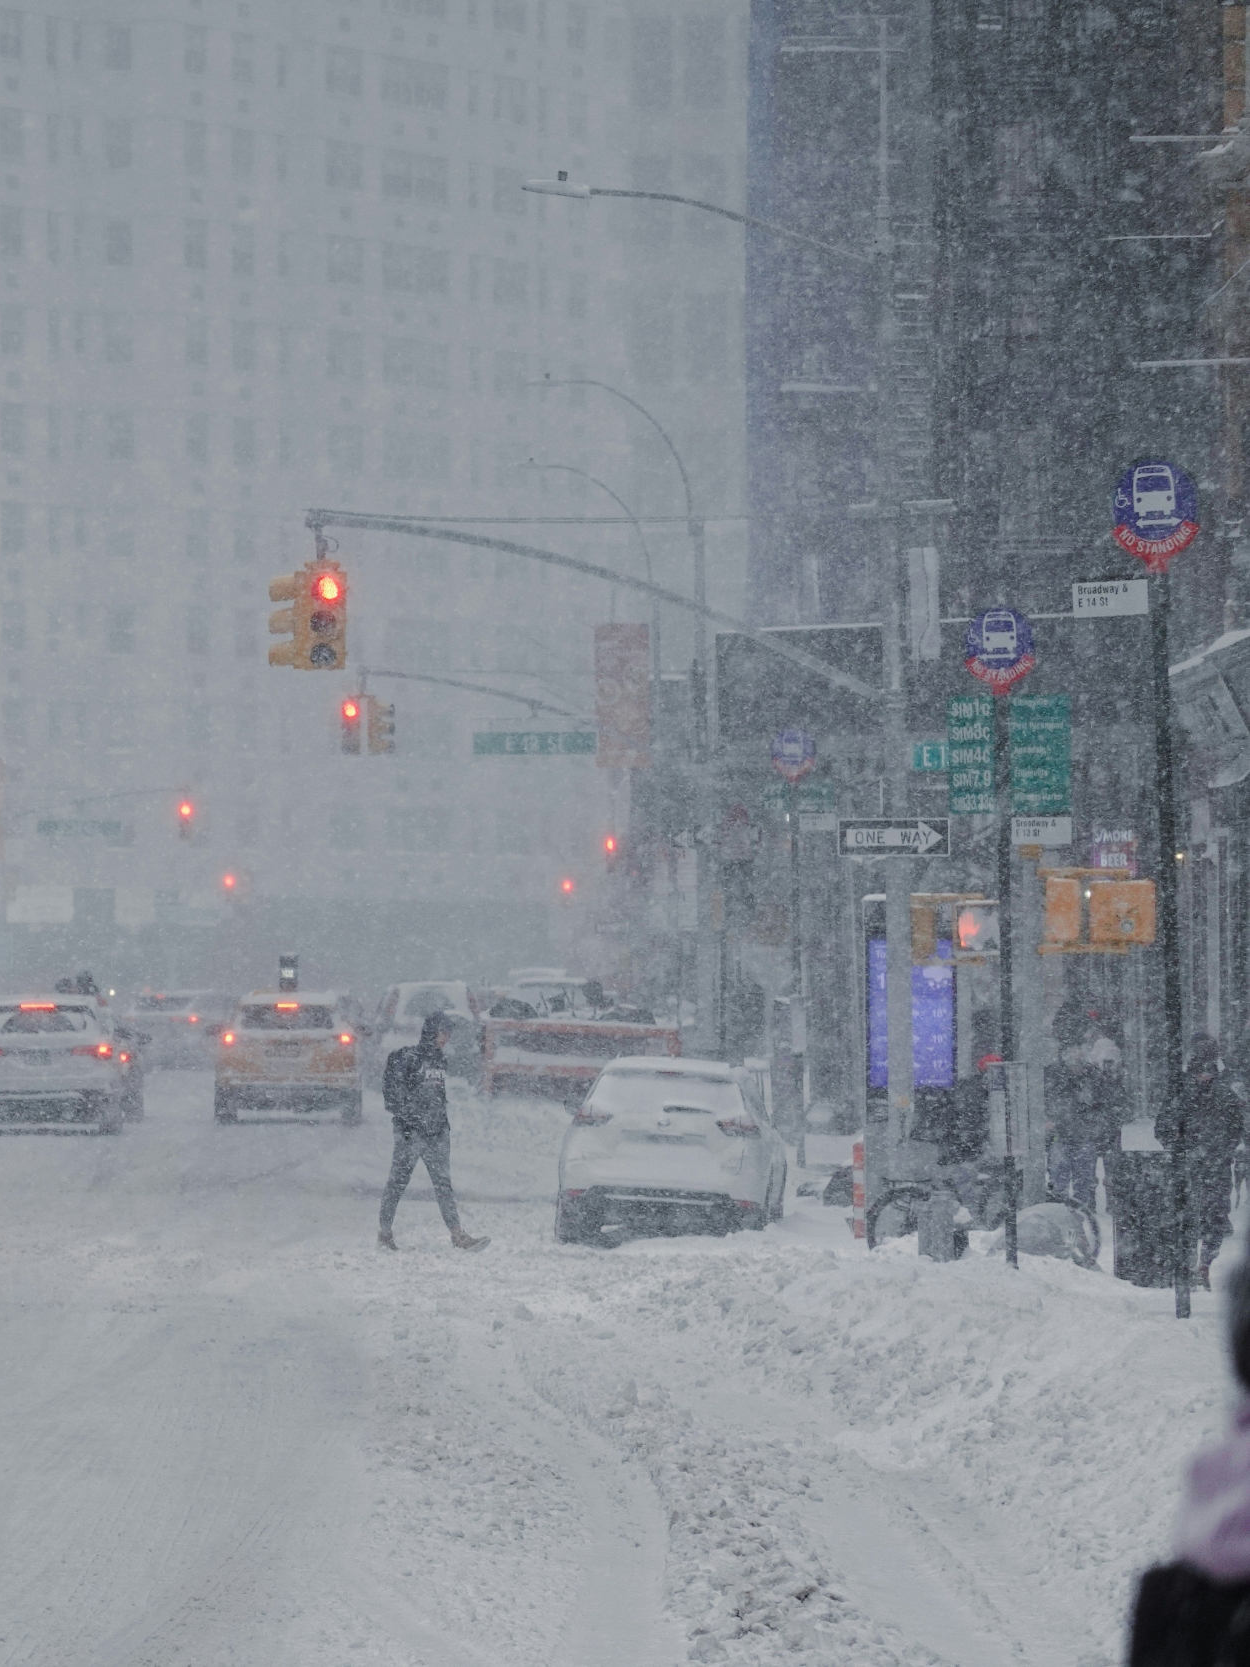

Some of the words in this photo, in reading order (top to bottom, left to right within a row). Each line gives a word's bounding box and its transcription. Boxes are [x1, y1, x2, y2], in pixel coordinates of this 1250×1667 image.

[1119, 528, 1136, 547] NO
[1136, 526, 1191, 554] STANDING
[1077, 584, 1119, 595] Broadway
[1122, 583, 1129, 593] &
[1078, 598, 1083, 608] E
[1099, 597, 1109, 607] St
[985, 659, 1030, 680] STANDING
[923, 746, 932, 767] E
[855, 830, 886, 845] ONE
[900, 830, 933, 845] WAY
[1100, 852, 1129, 868] BEER
